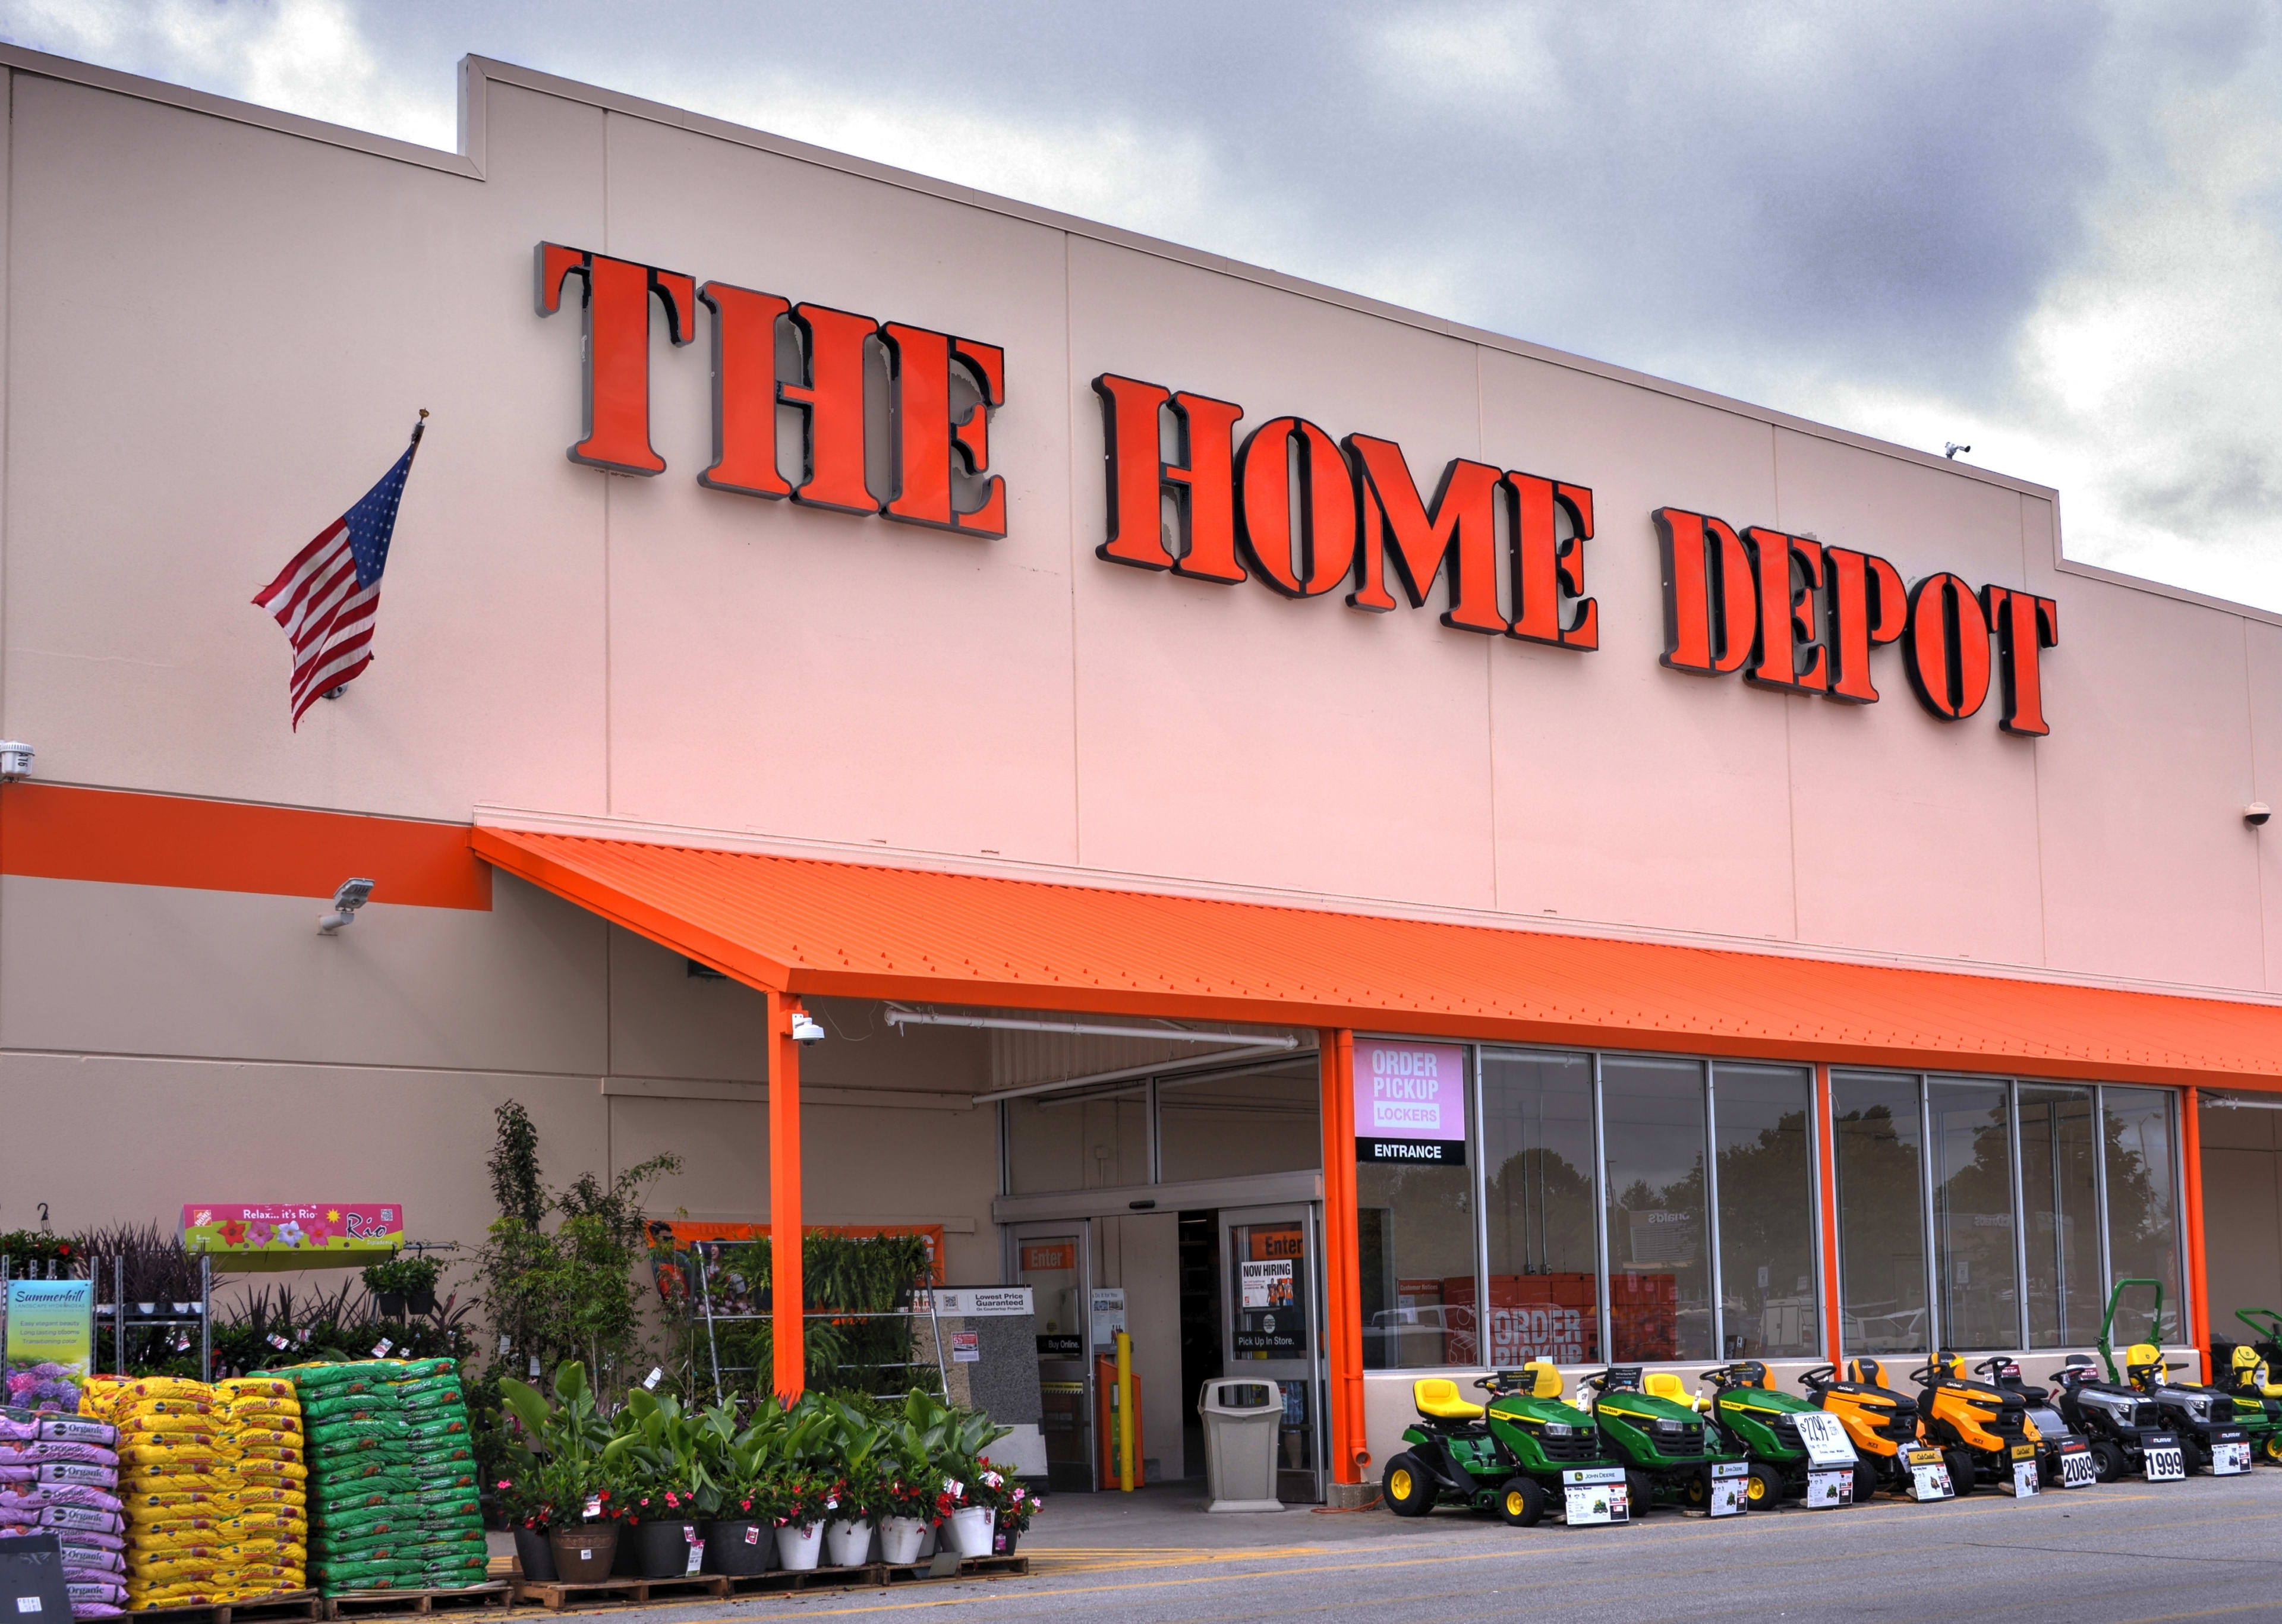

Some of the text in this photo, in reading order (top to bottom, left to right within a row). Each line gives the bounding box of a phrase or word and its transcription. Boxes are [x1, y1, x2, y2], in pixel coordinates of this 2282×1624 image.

[534, 241, 2057, 737] THE HOME DEPOT
[1372, 1049, 1437, 1077] ORDER
[1374, 1077, 1438, 1099] PICKUP
[1377, 1108, 1437, 1122] LOCKERS
[1375, 1144, 1442, 1159] ENTRANCE
[243, 1209, 315, 1219] Relax... it's Rio
[346, 1212, 386, 1241] Rio
[1265, 1236, 1303, 1256] Enter
[1031, 1250, 1063, 1267] Enter
[1243, 1263, 1291, 1278] NOW HIRING
[15, 1290, 84, 1303] Summerhill
[1494, 1309, 1582, 1344] ORDER
[1048, 1340, 1079, 1349] Buy Online.
[1255, 1338, 1264, 1347] Up
[1274, 1337, 1294, 1345] Store.
[68, 1424, 104, 1434] Organic
[2063, 1456, 2094, 1483] 2089
[2146, 1452, 2183, 1475] 1999
[68, 1467, 104, 1477] Organic
[68, 1510, 104, 1522] Organic
[68, 1550, 104, 1560] Organic
[68, 1586, 104, 1594] Organic
